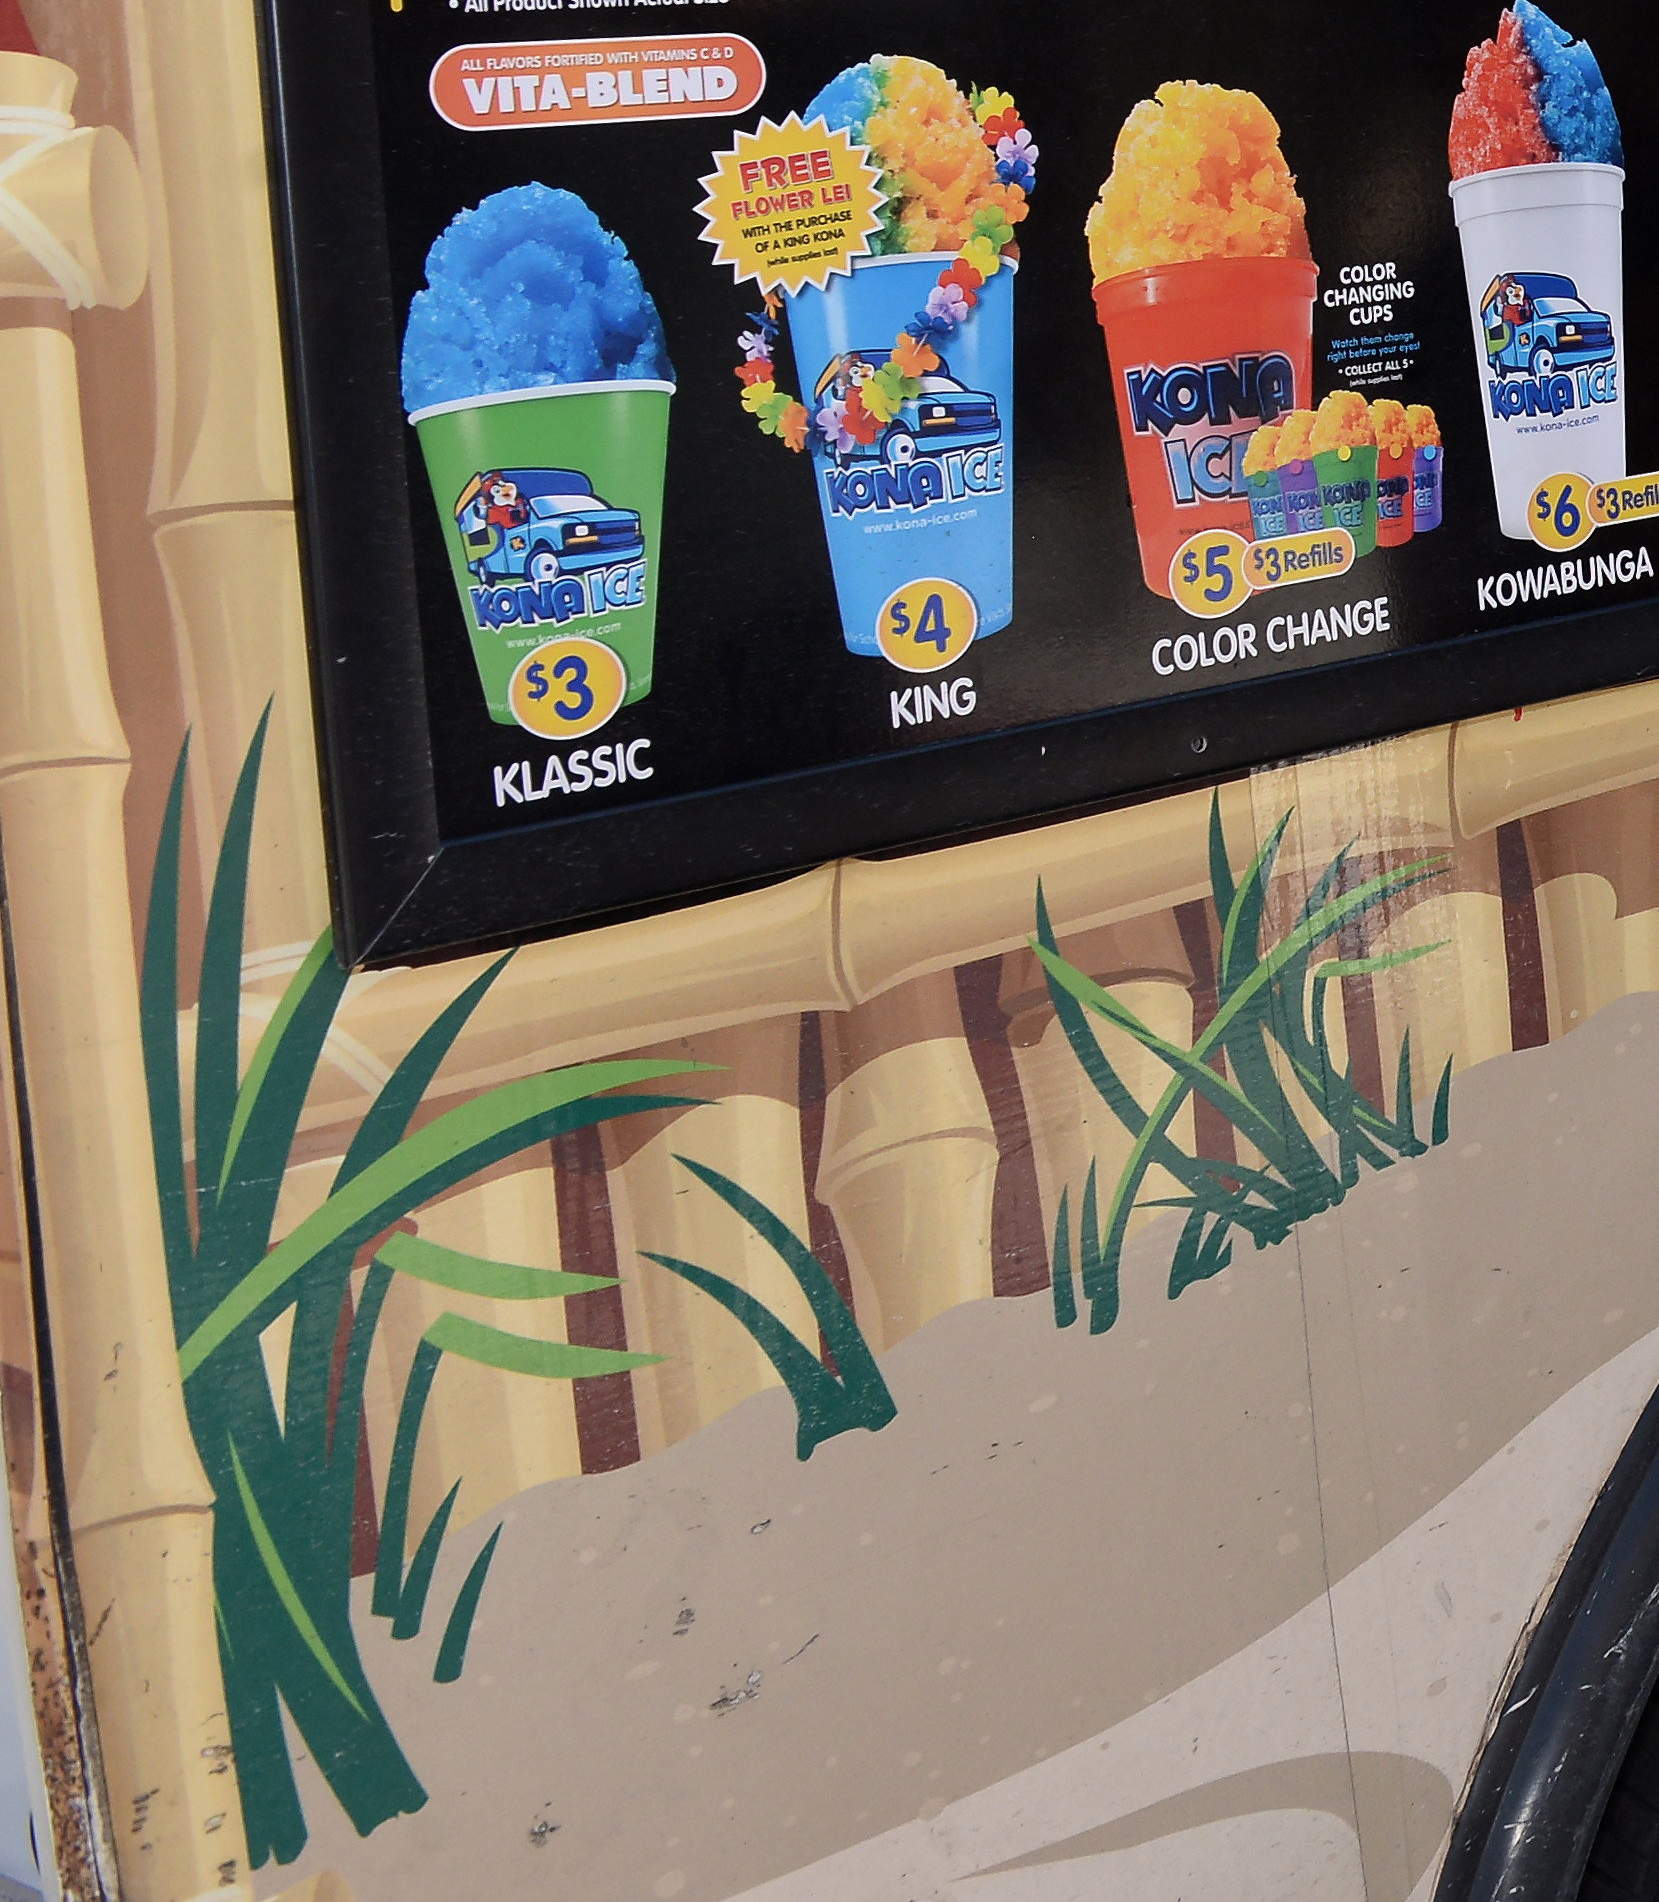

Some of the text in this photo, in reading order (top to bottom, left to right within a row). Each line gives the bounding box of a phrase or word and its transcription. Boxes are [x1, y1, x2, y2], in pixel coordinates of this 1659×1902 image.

[462, 65, 738, 115] VITA-BLEND
[739, 149, 834, 193] FREE
[731, 183, 852, 220] FLOWER LEI
[1324, 281, 1415, 308] CHANGING
[1339, 261, 1397, 285] COLOR
[1349, 304, 1394, 326] CUPS
[825, 445, 1004, 519] KONA ICE
[1535, 484, 1581, 538] $6
[470, 560, 647, 632] KONA ICE
[1181, 544, 1233, 602] $5
[1478, 547, 1653, 610] KOWABUNGA
[890, 594, 951, 652] $4
[1153, 597, 1390, 675] COLOR CHANGE
[526, 655, 594, 721] $3
[891, 678, 976, 728] KING
[494, 739, 653, 806] KLASSIC
